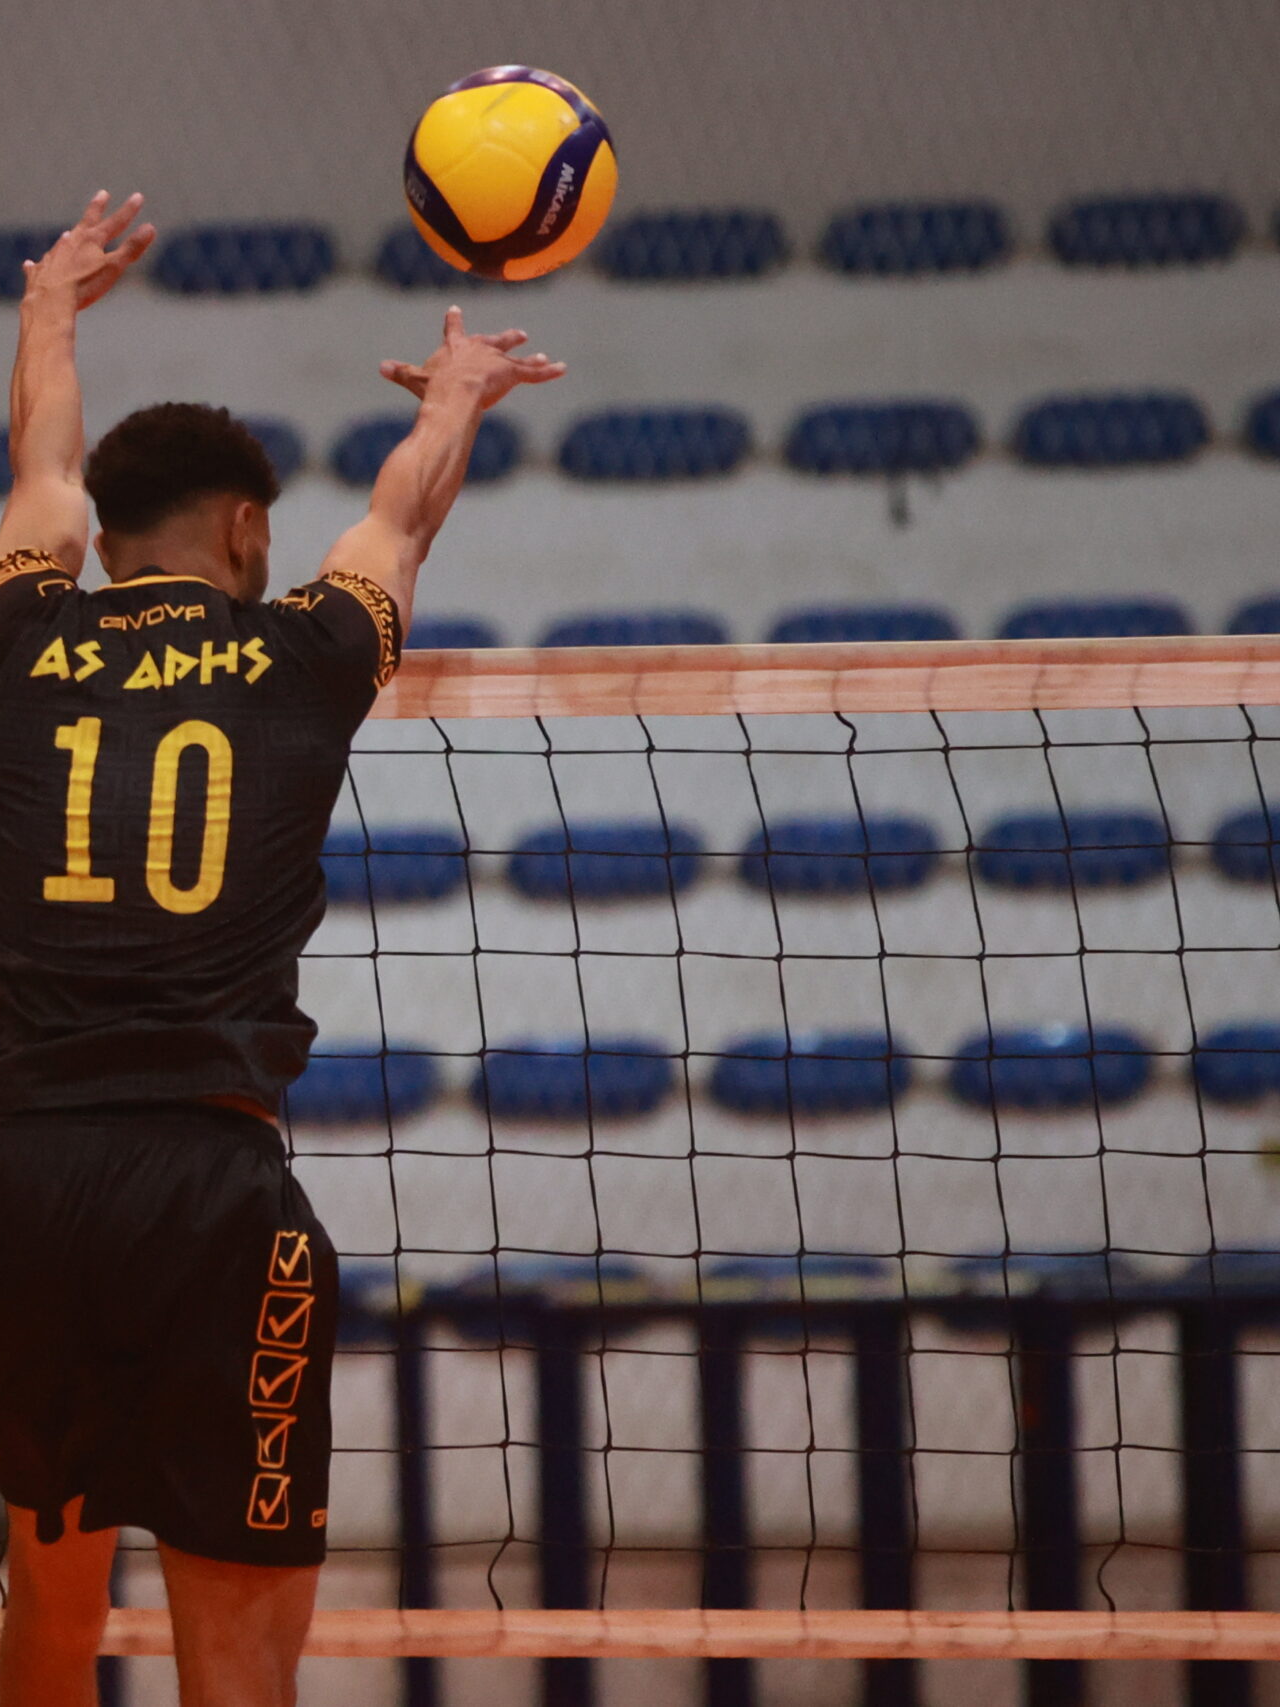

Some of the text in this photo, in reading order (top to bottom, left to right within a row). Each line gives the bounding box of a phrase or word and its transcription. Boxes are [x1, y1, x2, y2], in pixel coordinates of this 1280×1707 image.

[100, 603, 205, 631] GIVOVA
[30, 637, 105, 682] AS
[43, 716, 233, 914] 10
